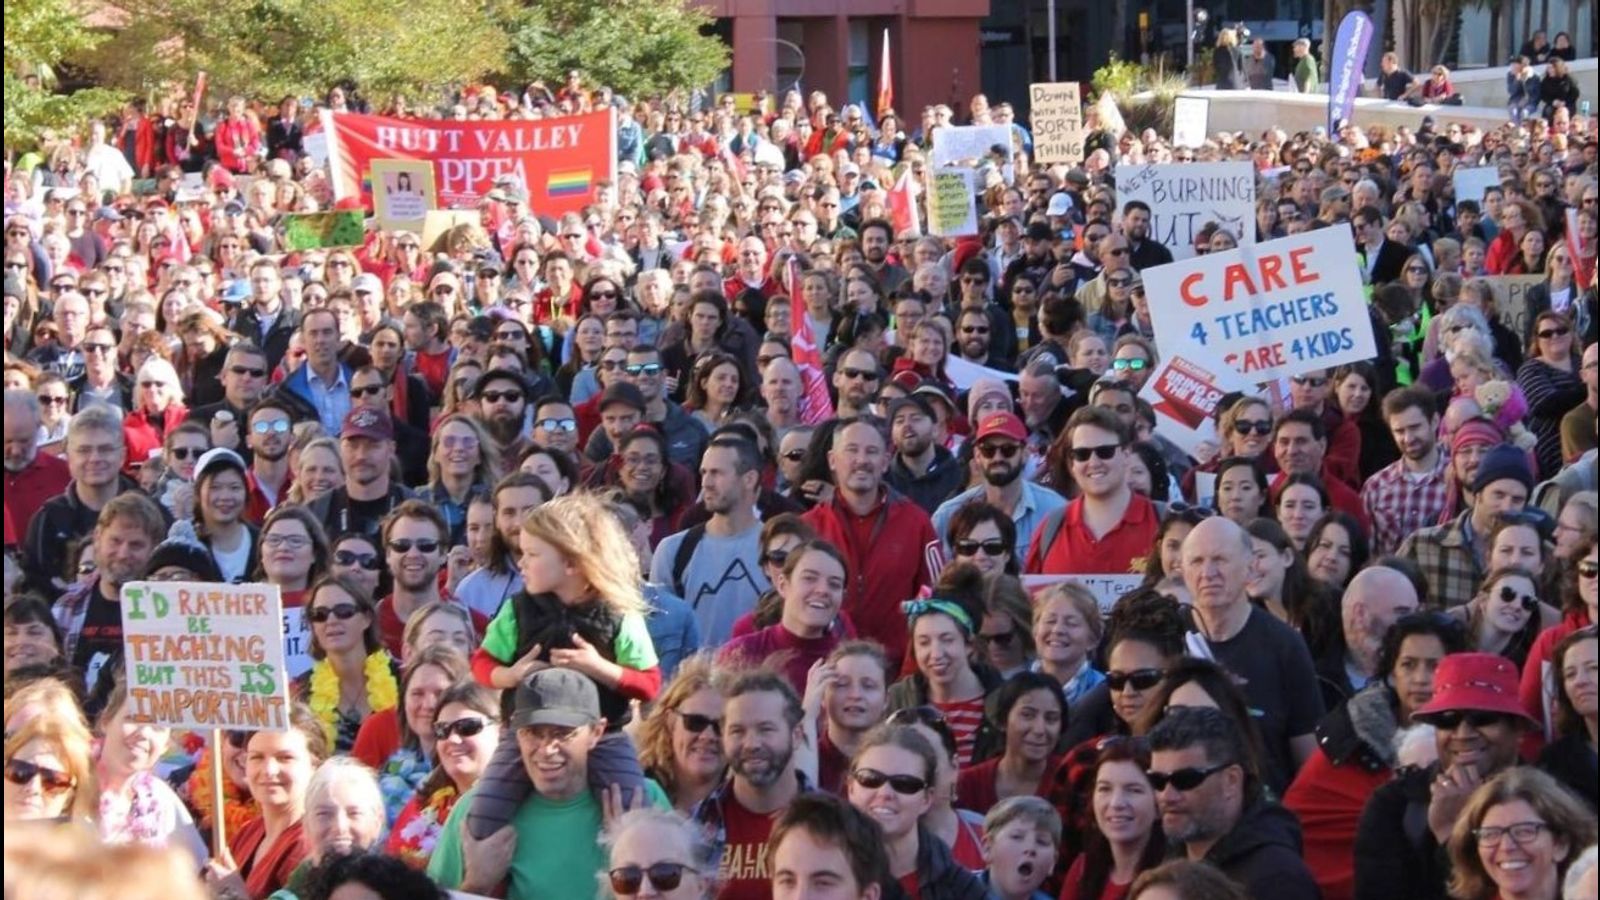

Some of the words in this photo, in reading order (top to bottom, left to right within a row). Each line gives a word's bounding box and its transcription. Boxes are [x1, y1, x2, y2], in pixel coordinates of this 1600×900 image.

[1346, 15, 1366, 58] School
[1033, 108, 1056, 117] WITH
[1058, 106, 1079, 116] THIS
[375, 126, 463, 153] HUTT
[475, 124, 584, 152] VALLEY
[1034, 119, 1077, 136] SORT
[1049, 133, 1063, 141] OF
[1035, 143, 1081, 158] THING
[439, 158, 530, 197] PPTA
[1152, 176, 1252, 203] BURNING
[1149, 212, 1201, 246] UT
[1180, 247, 1320, 307] CARE
[1190, 322, 1208, 345] 4
[1215, 292, 1339, 340] TEACHERS
[1167, 368, 1207, 396] BRING
[125, 586, 169, 620] I'D
[178, 589, 268, 616] RATHER
[188, 617, 213, 634] BE
[127, 635, 265, 664] TEACHING
[136, 664, 176, 685] BUT
[181, 666, 232, 688] THIS
[240, 664, 276, 695] IS
[126, 687, 285, 728] IMPORTANT
